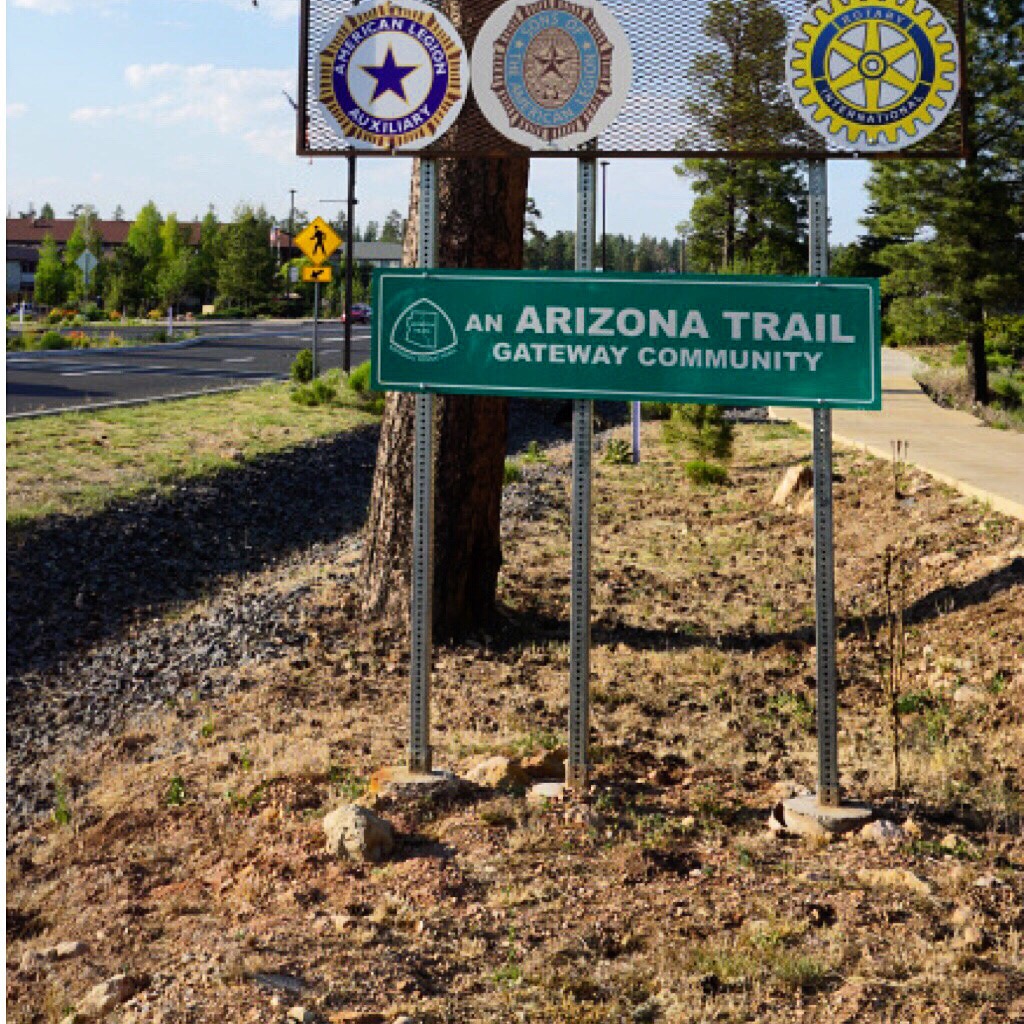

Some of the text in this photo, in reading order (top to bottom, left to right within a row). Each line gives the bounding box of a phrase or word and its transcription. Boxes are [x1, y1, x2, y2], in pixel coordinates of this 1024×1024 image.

[336, 19, 447, 75] AMERICAN LEGION
[348, 104, 431, 133] AUXILIARY
[465, 306, 856, 343] AN ARIZONA TRAIL
[493, 343, 823, 372] GATEWAY COMMUNITY
